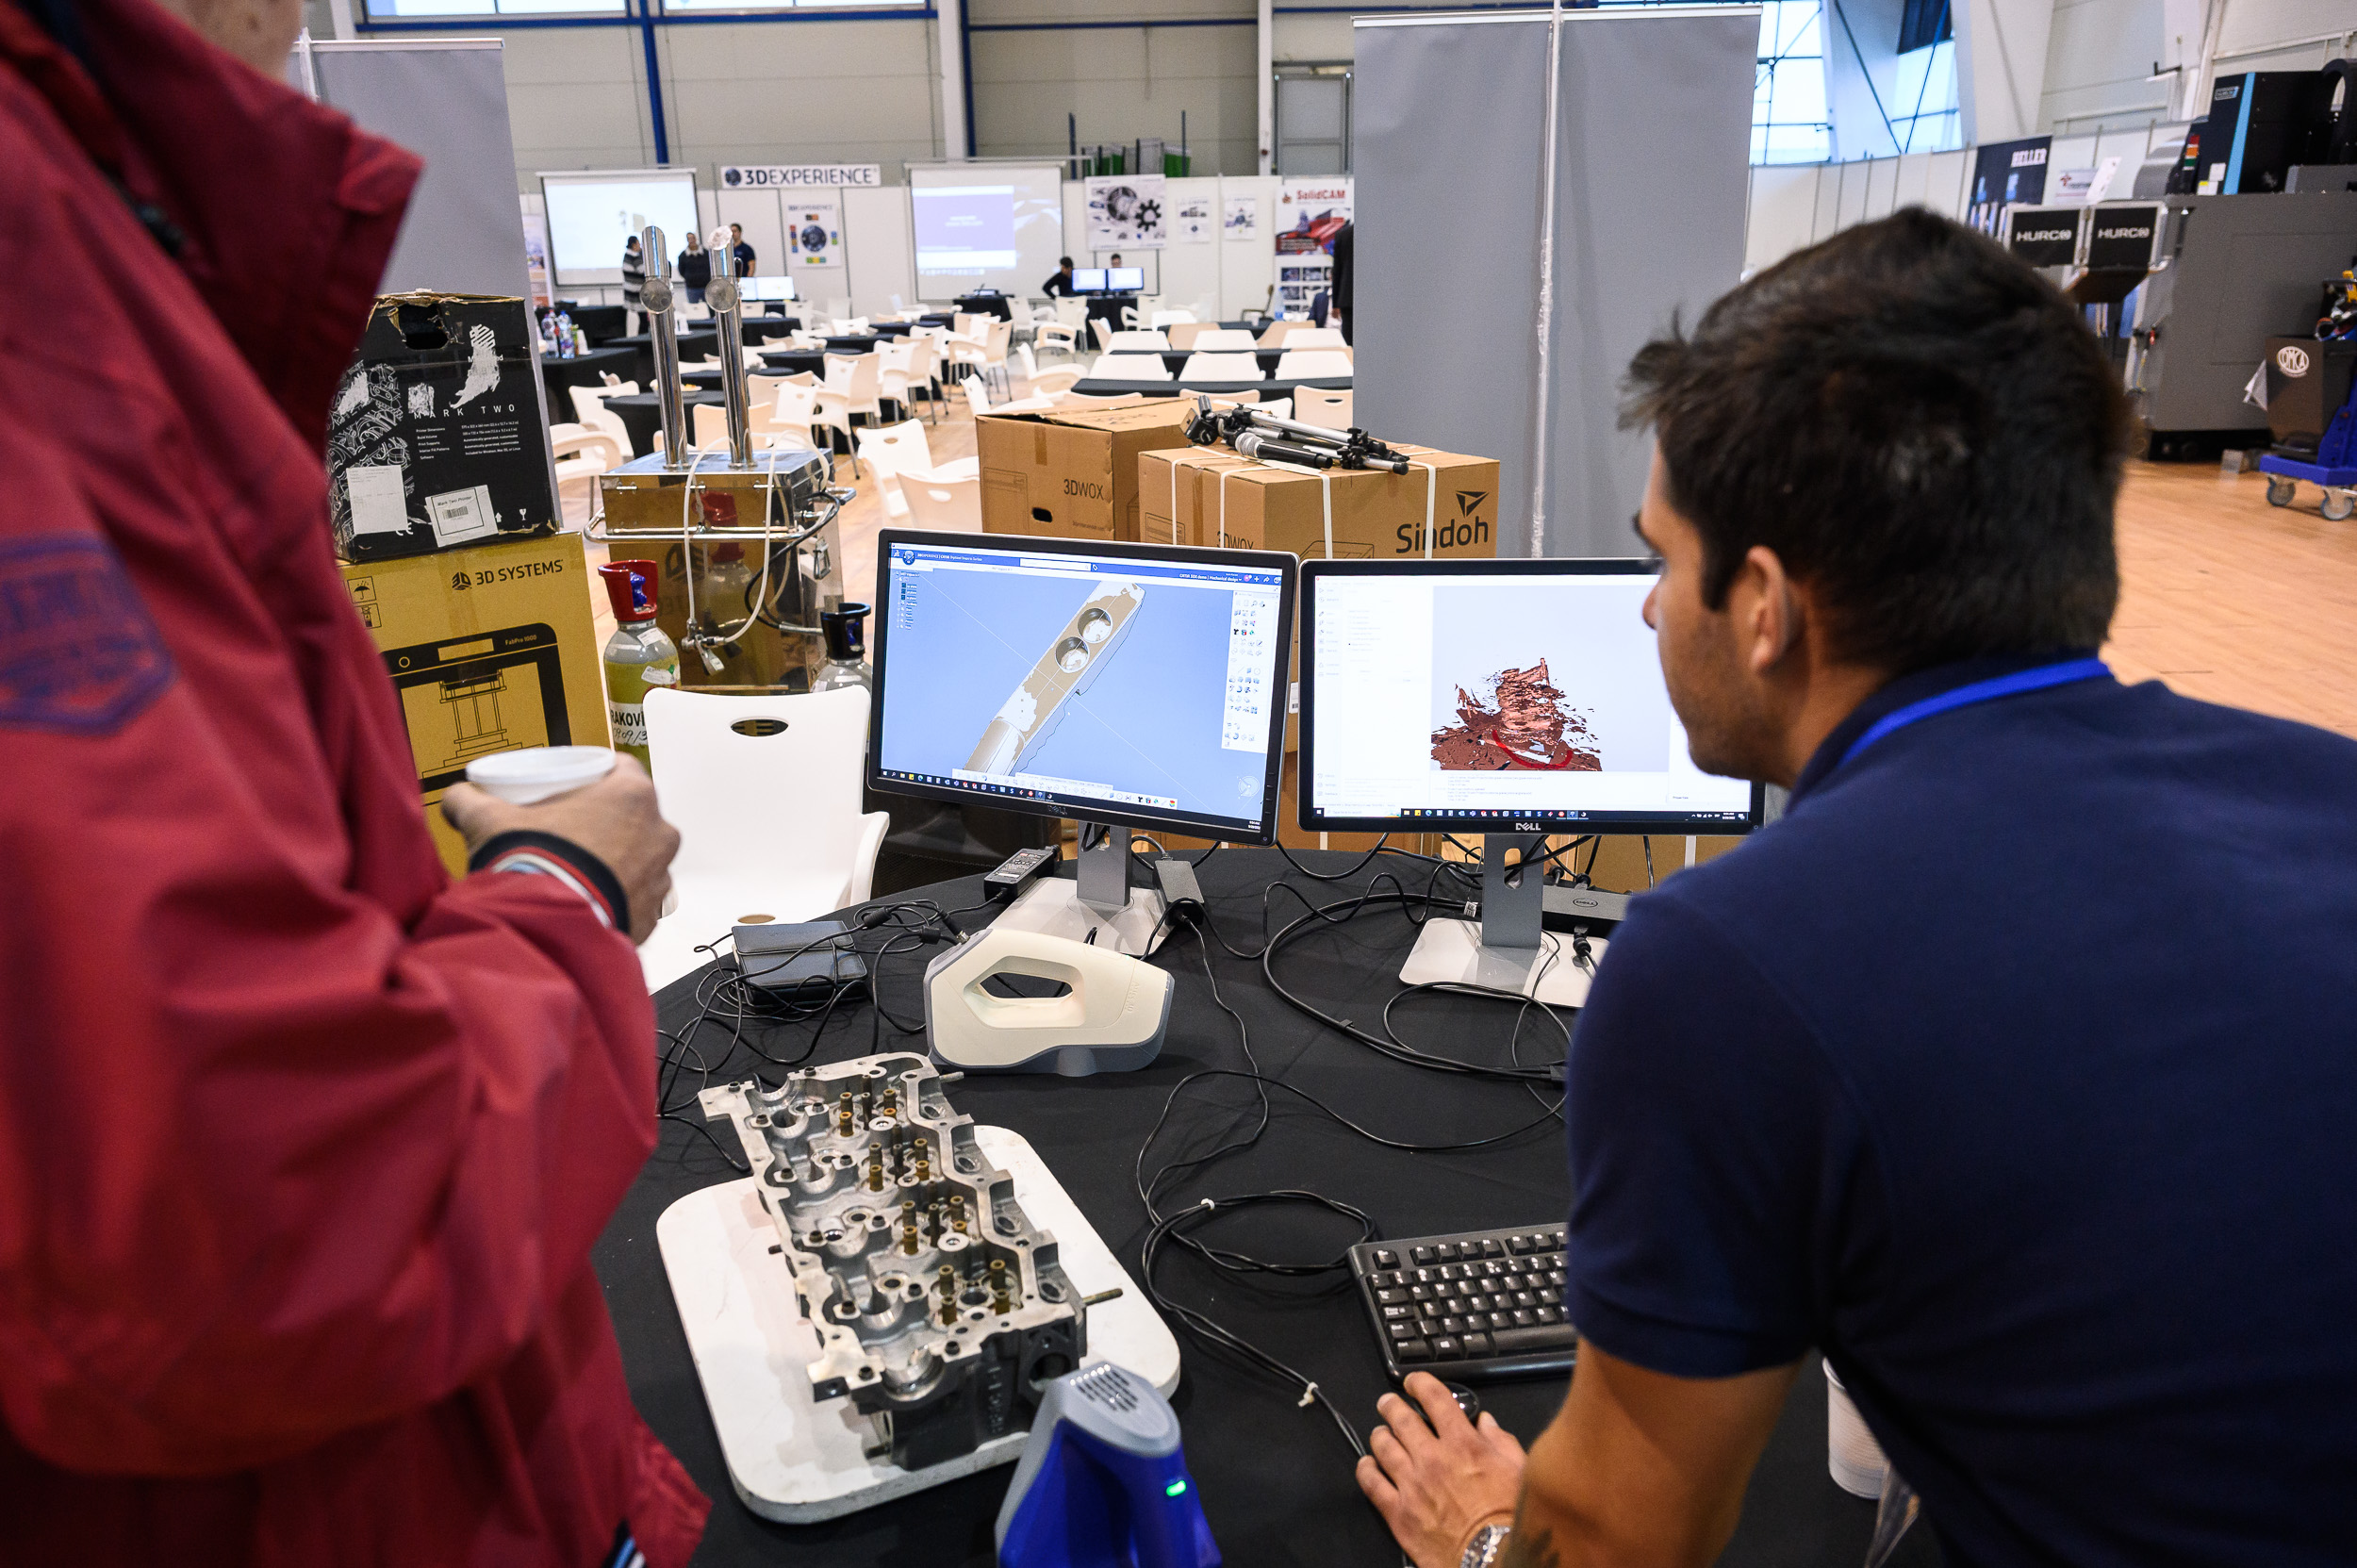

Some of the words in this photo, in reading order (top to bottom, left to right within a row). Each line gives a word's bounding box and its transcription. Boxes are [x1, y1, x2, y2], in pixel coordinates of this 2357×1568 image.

[744, 168, 872, 185] 3DEXPERIENCE
[1296, 190, 1345, 200] SolidCAM
[2016, 229, 2072, 242] HURCO
[2098, 226, 2151, 239] HURCO
[414, 407, 464, 420] MARK
[481, 404, 515, 415] TWO
[1063, 478, 1105, 501] 3DWOX
[1395, 516, 1489, 553] Sindoh
[475, 569, 495, 586] 3D
[498, 559, 563, 582] SYSTEMS
[1515, 822, 1541, 831] DELL
